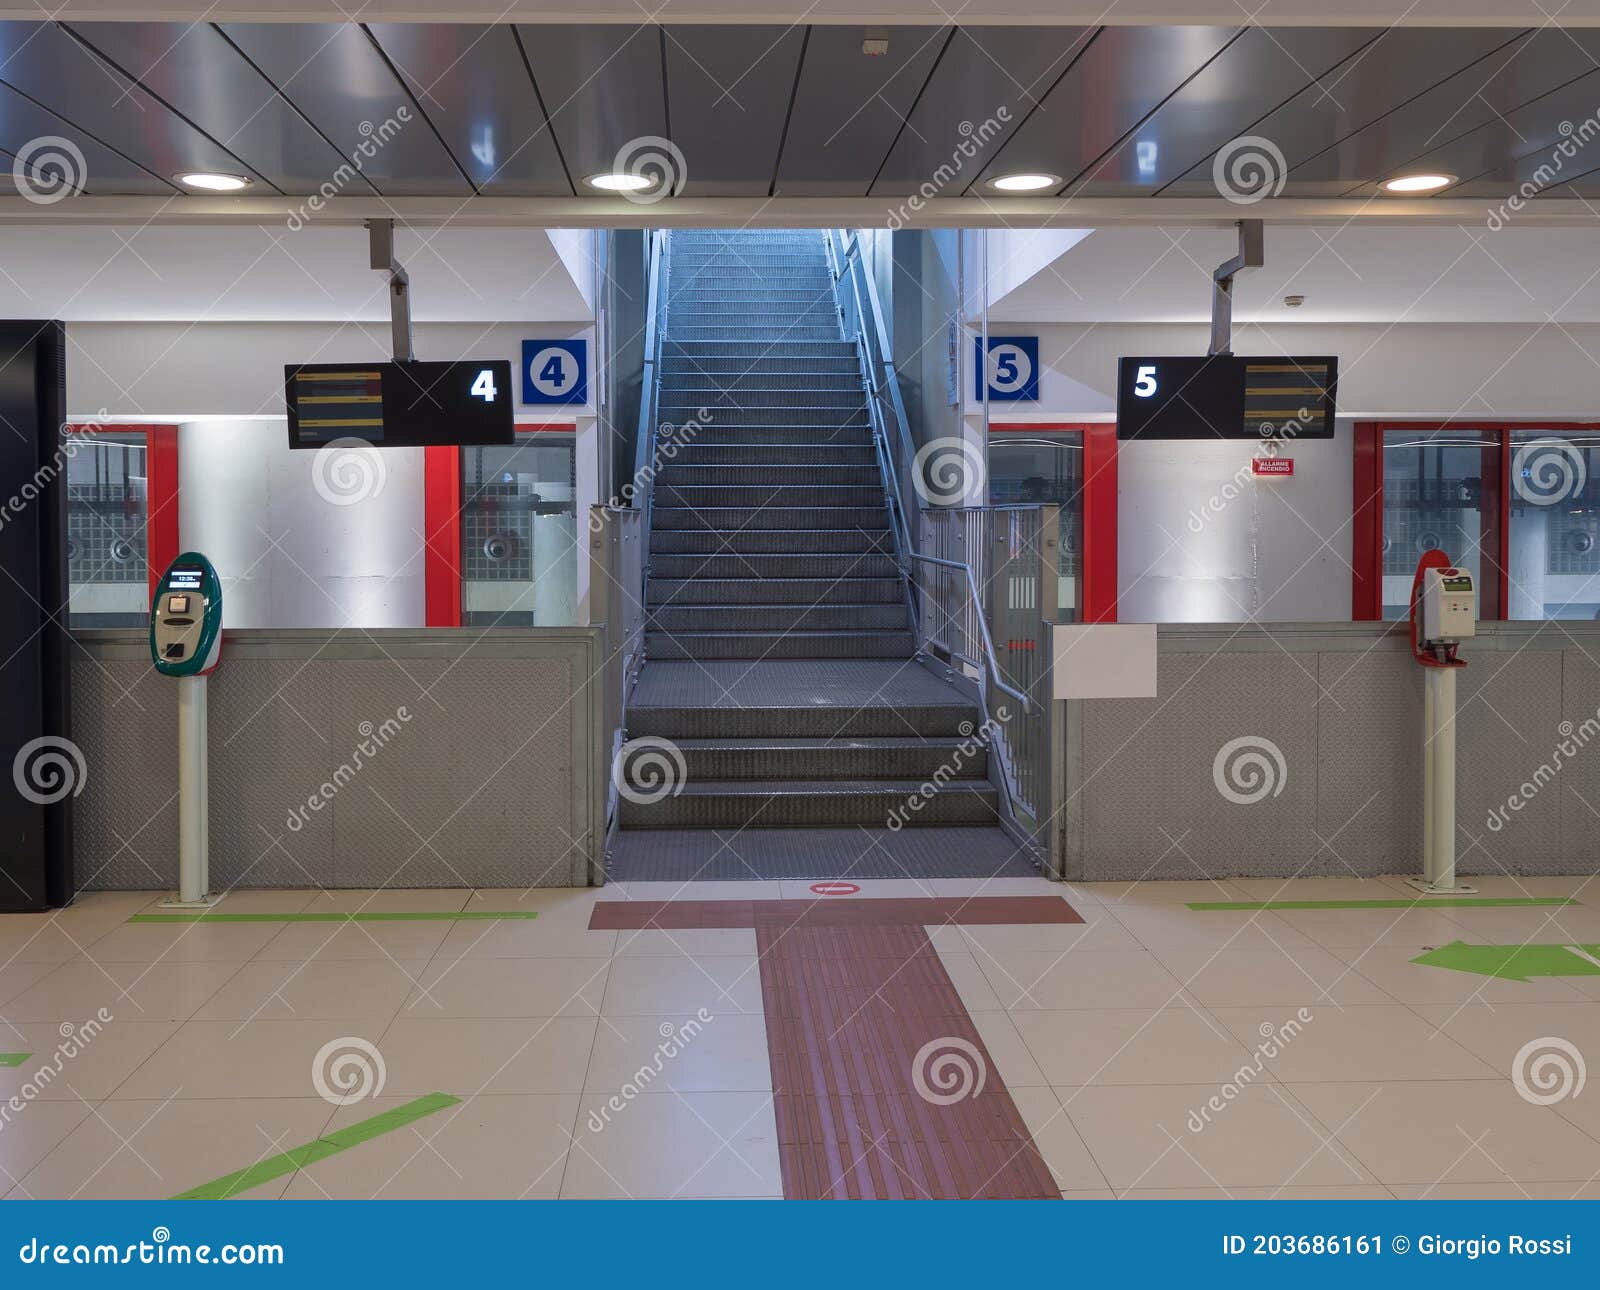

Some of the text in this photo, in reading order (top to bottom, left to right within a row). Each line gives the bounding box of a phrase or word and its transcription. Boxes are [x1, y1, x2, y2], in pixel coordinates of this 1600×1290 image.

[539, 356, 566, 387] 4
[996, 352, 1018, 384] 5
[1134, 366, 1157, 397] 5
[470, 370, 497, 402] 4
